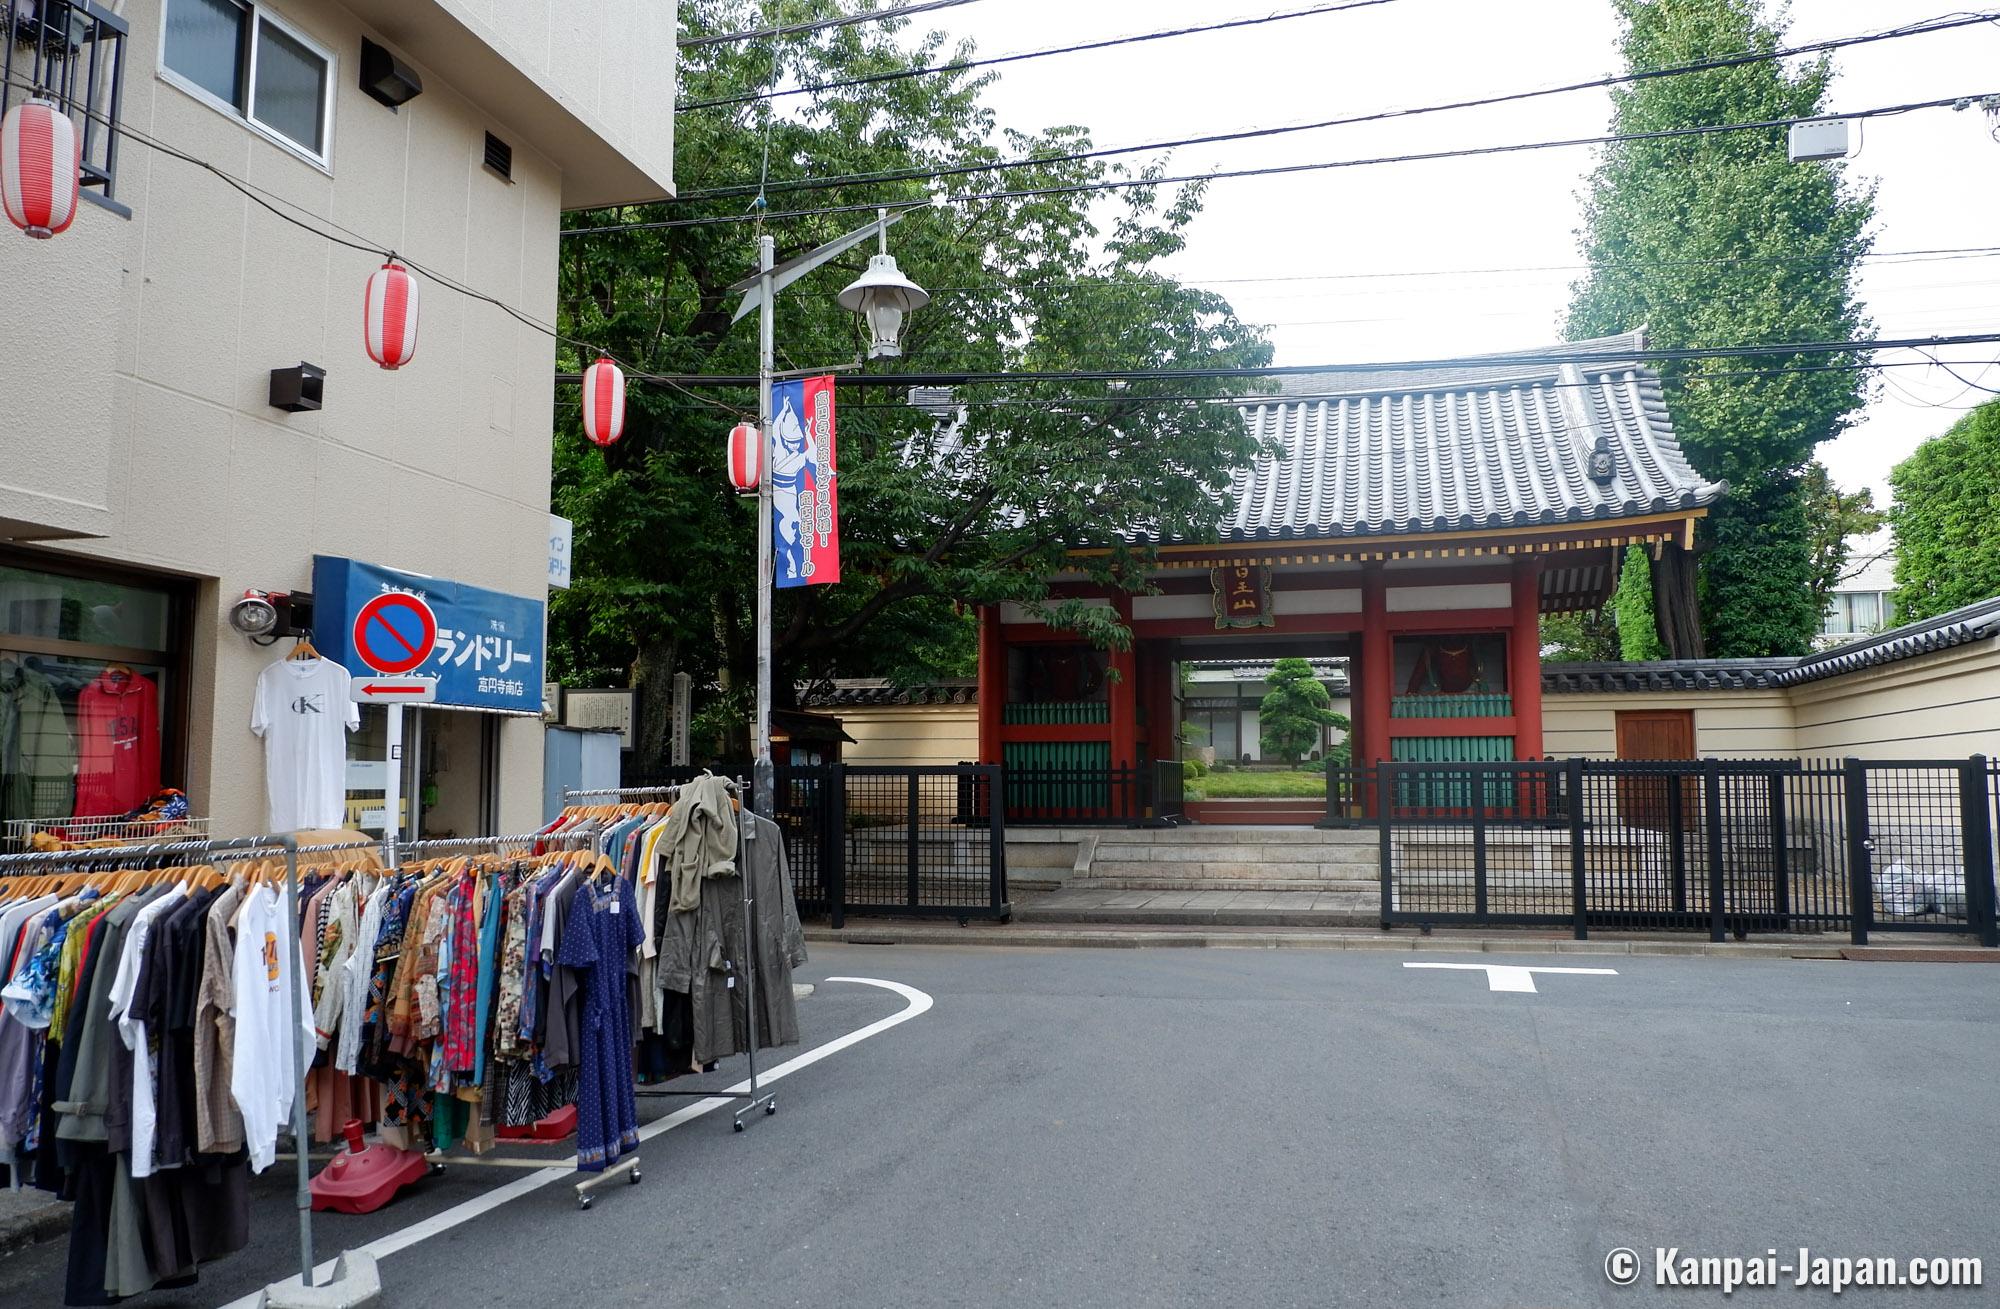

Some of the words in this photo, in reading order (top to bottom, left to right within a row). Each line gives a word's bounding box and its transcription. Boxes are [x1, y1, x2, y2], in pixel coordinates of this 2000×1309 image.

[436, 628, 532, 674] ランドリー
[478, 676, 524, 697] 高円寺南店
